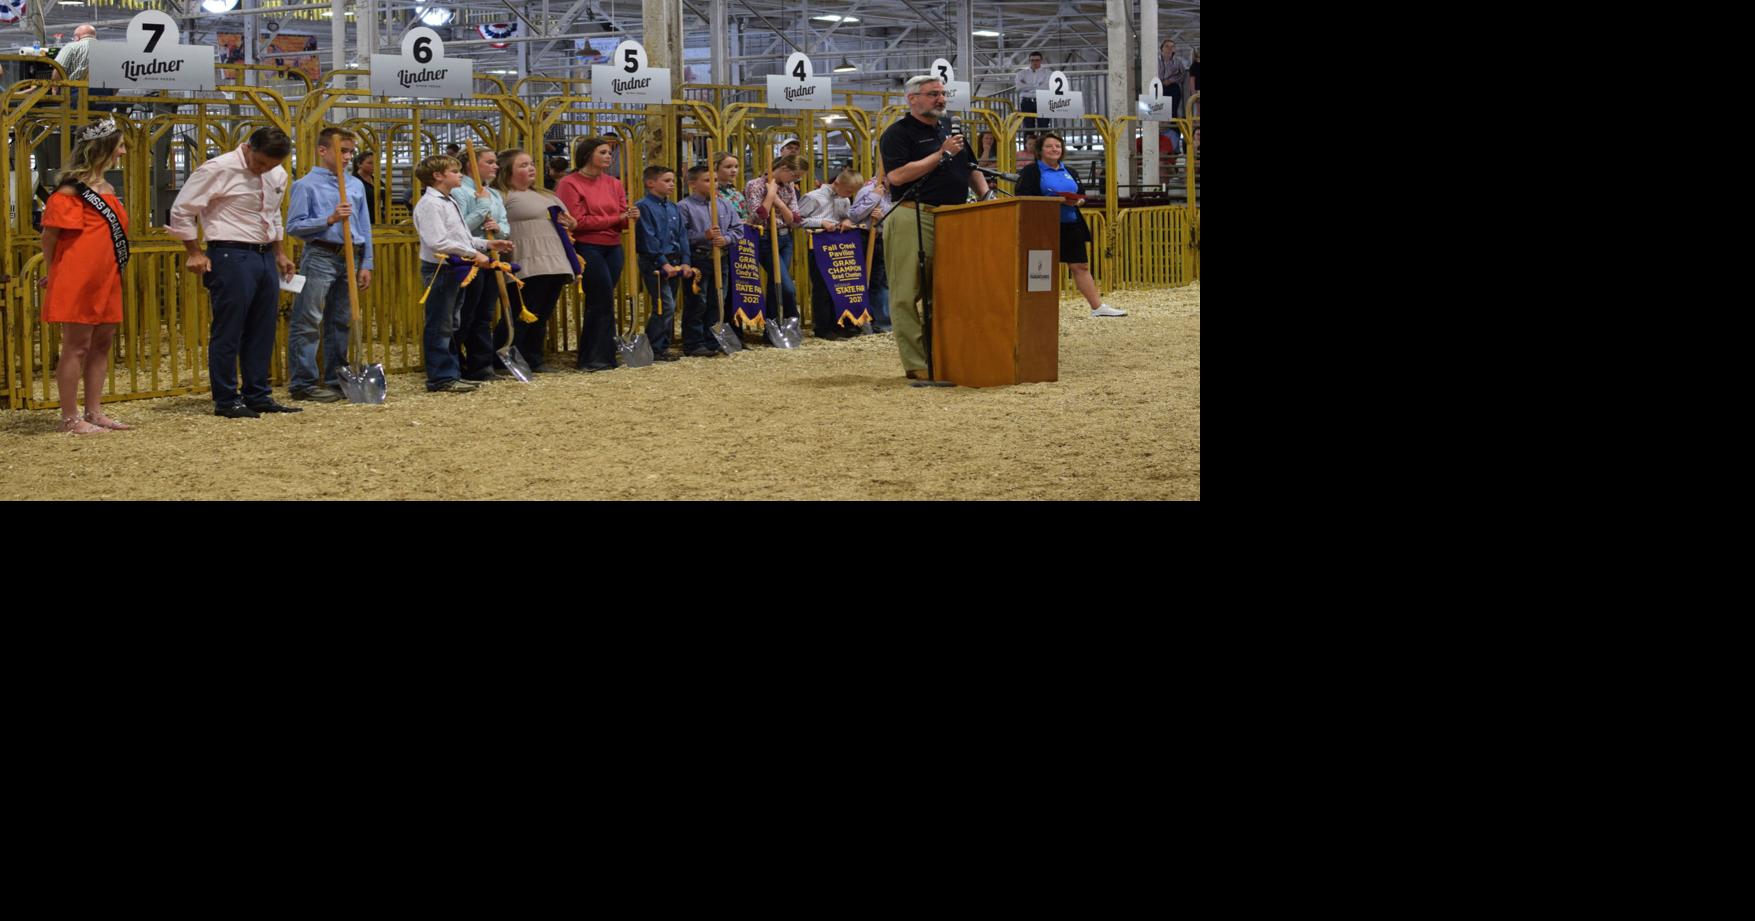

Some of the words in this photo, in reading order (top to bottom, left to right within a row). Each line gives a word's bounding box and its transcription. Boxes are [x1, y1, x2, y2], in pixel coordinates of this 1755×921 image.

[142, 23, 165, 53] 7
[413, 37, 433, 64] 6
[121, 58, 184, 82] Lindner
[624, 49, 639, 73] 5
[397, 68, 448, 88] Lindner
[792, 60, 806, 82] 4
[937, 65, 948, 84] 3
[611, 77, 652, 95] Lindner
[784, 85, 816, 102] Lindner
[1054, 77, 1064, 95] 2
[1154, 83, 1158, 100] 1
[82, 189, 106, 210] MISS
[822, 244, 837, 252] Fall
[838, 242, 856, 250] Creek
[828, 265, 862, 275] CHAMPION
[833, 259, 856, 267] GRAND
[735, 283, 753, 293] STATE
[835, 286, 856, 294] STATE
[743, 296, 759, 304] 2021
